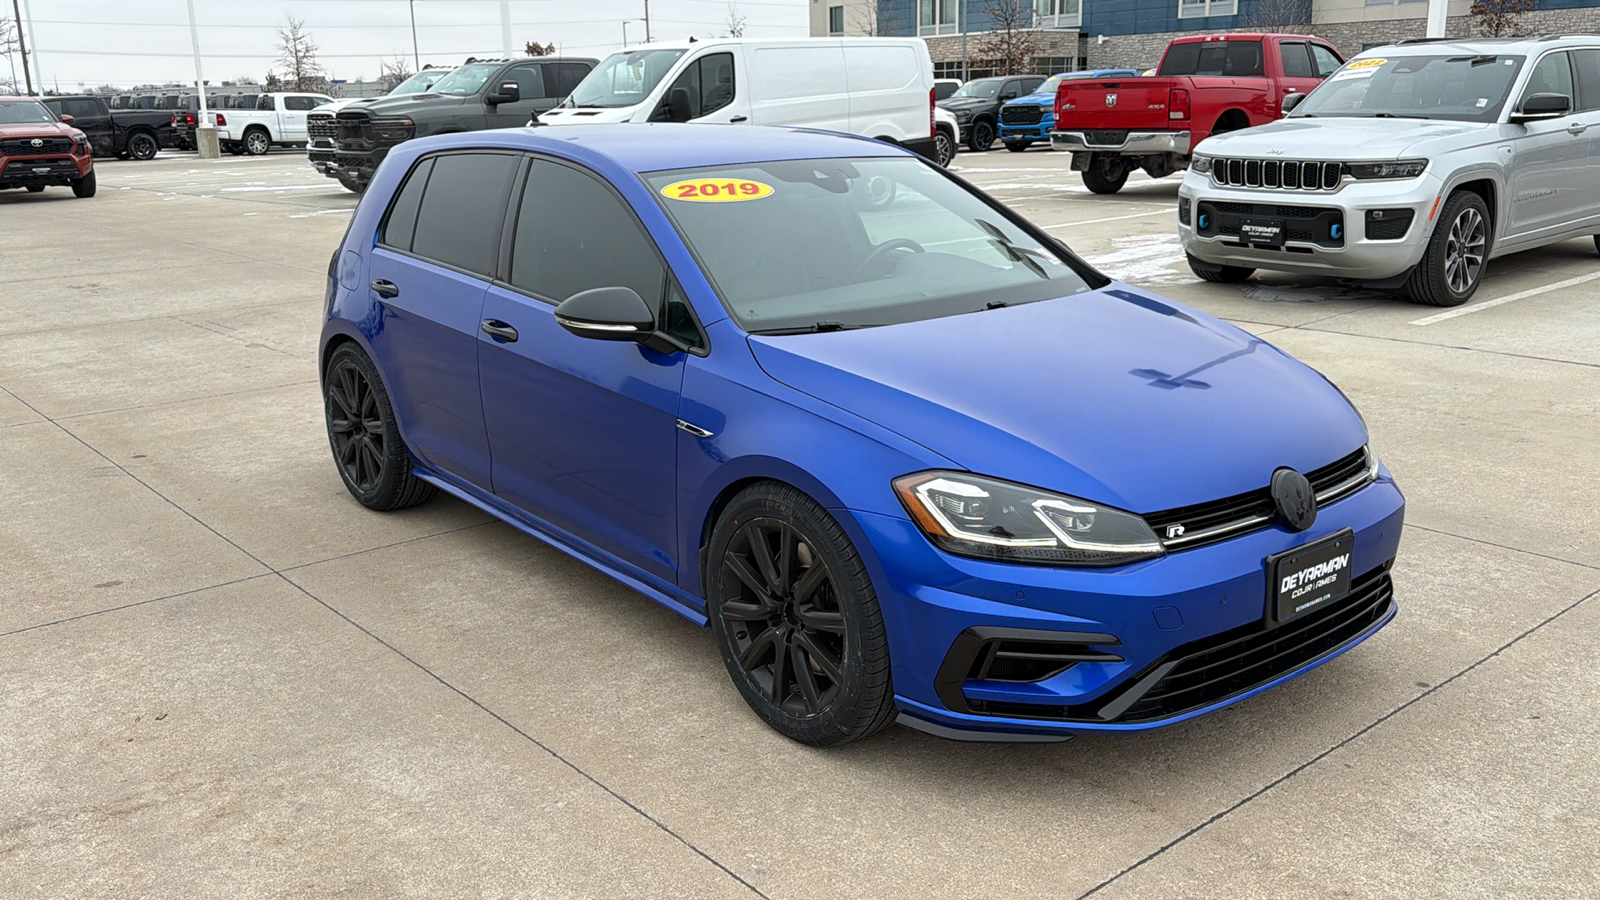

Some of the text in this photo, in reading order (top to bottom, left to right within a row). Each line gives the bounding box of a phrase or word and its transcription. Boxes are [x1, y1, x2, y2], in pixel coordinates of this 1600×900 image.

[677, 183, 760, 197] 2019
[1167, 524, 1185, 538] R
[1280, 553, 1350, 594] DEYARMAN
[1315, 573, 1338, 589] AMES
